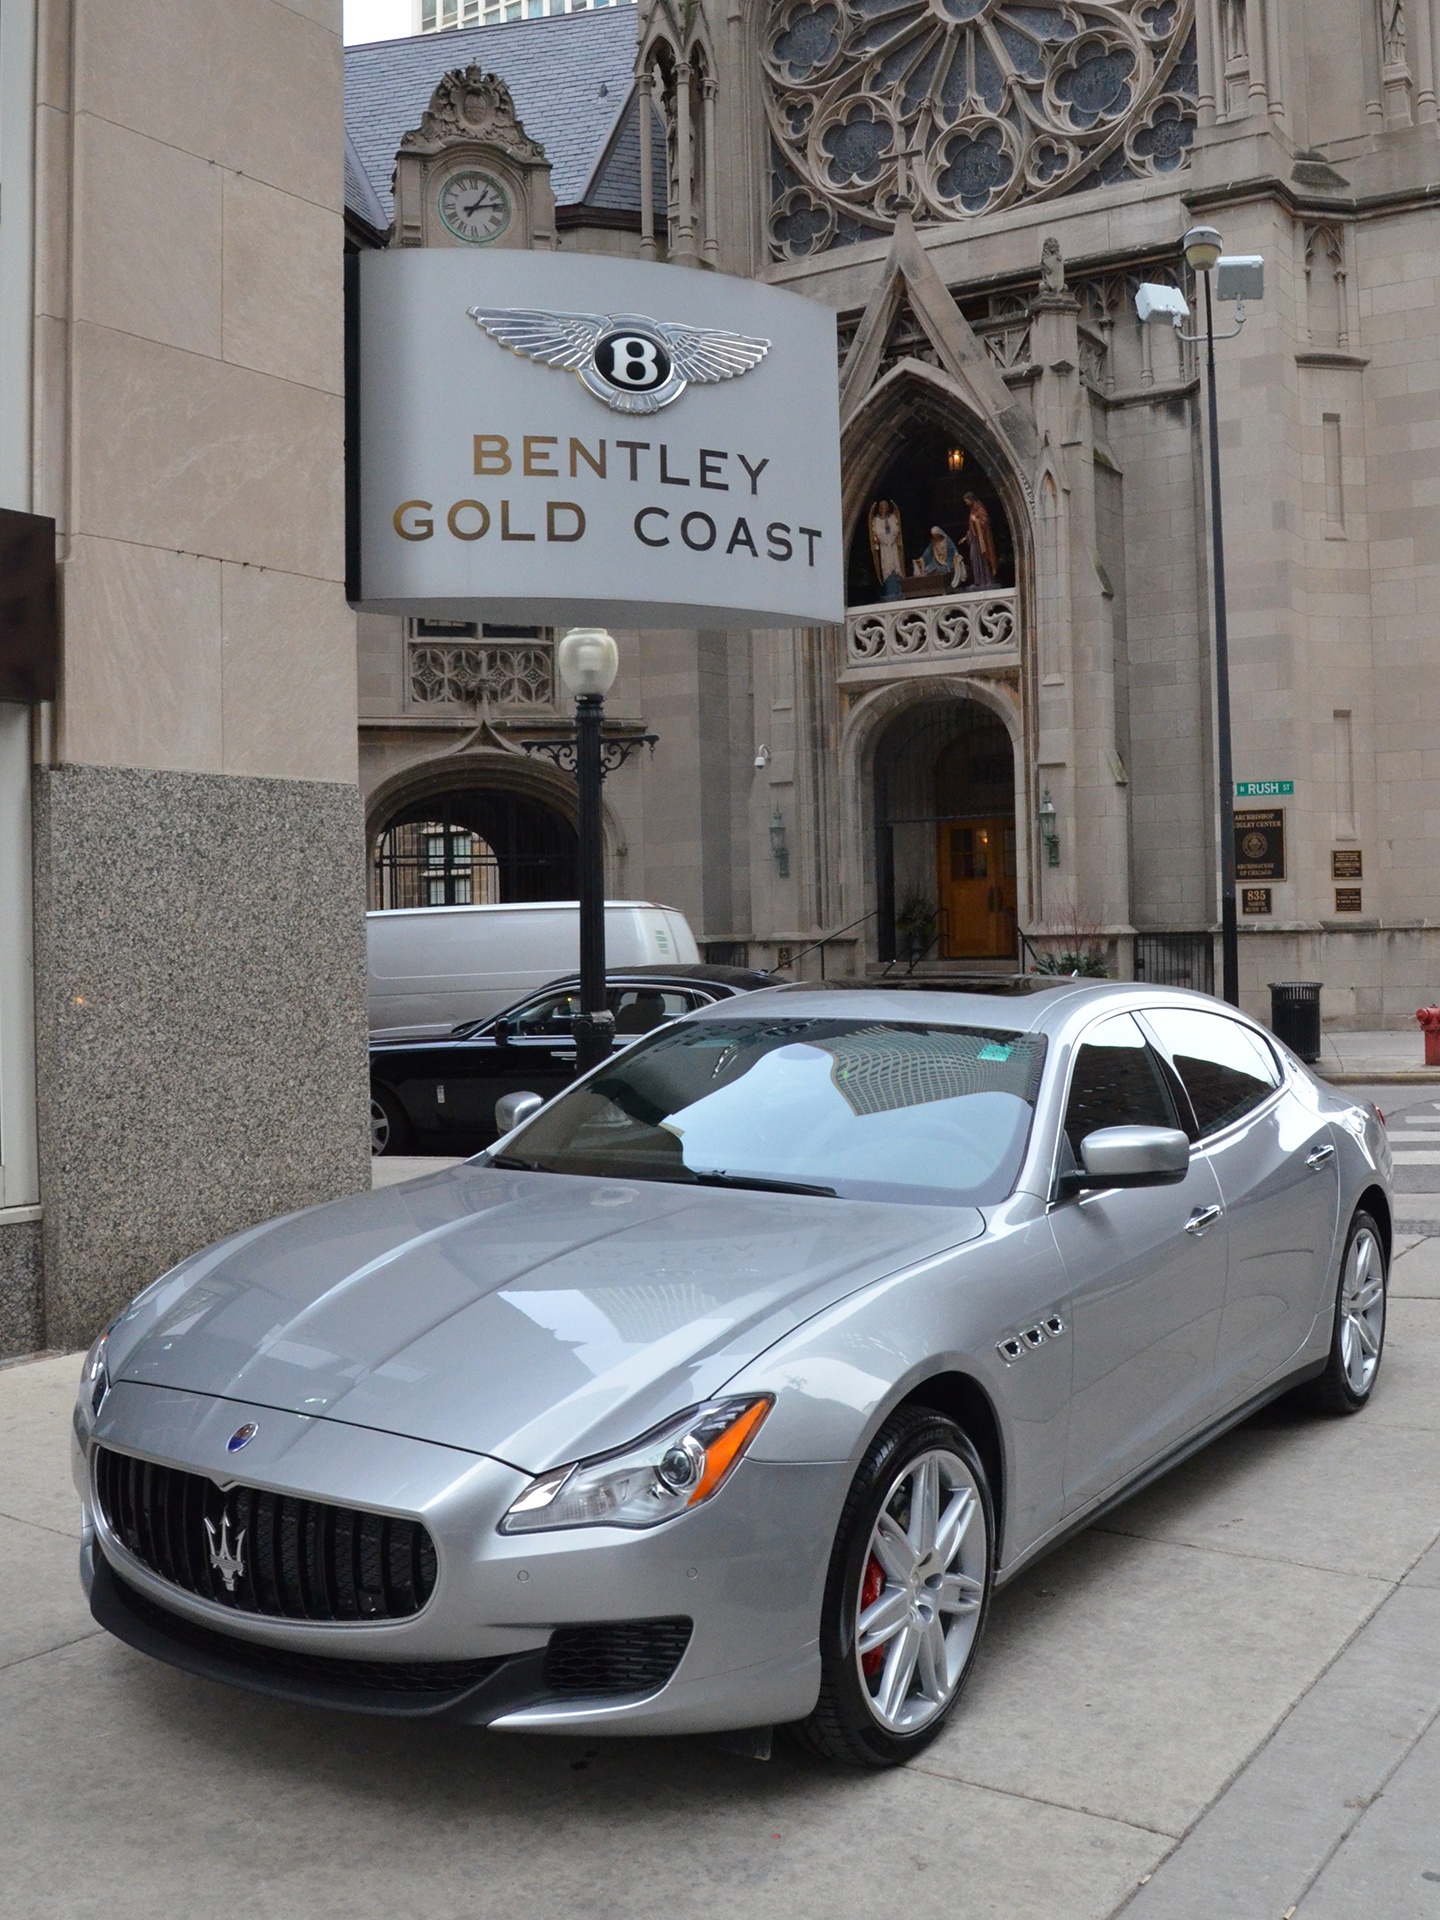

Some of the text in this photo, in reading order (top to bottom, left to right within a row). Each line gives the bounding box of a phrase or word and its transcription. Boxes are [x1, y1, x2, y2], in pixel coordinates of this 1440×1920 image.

[610, 336, 659, 386] B
[473, 434, 770, 496] BENTLEY
[393, 499, 822, 567] GOLD COAST
[1247, 783, 1279, 794] RUSH
[1255, 820, 1282, 828] CENTER
[1247, 890, 1266, 901] 835
